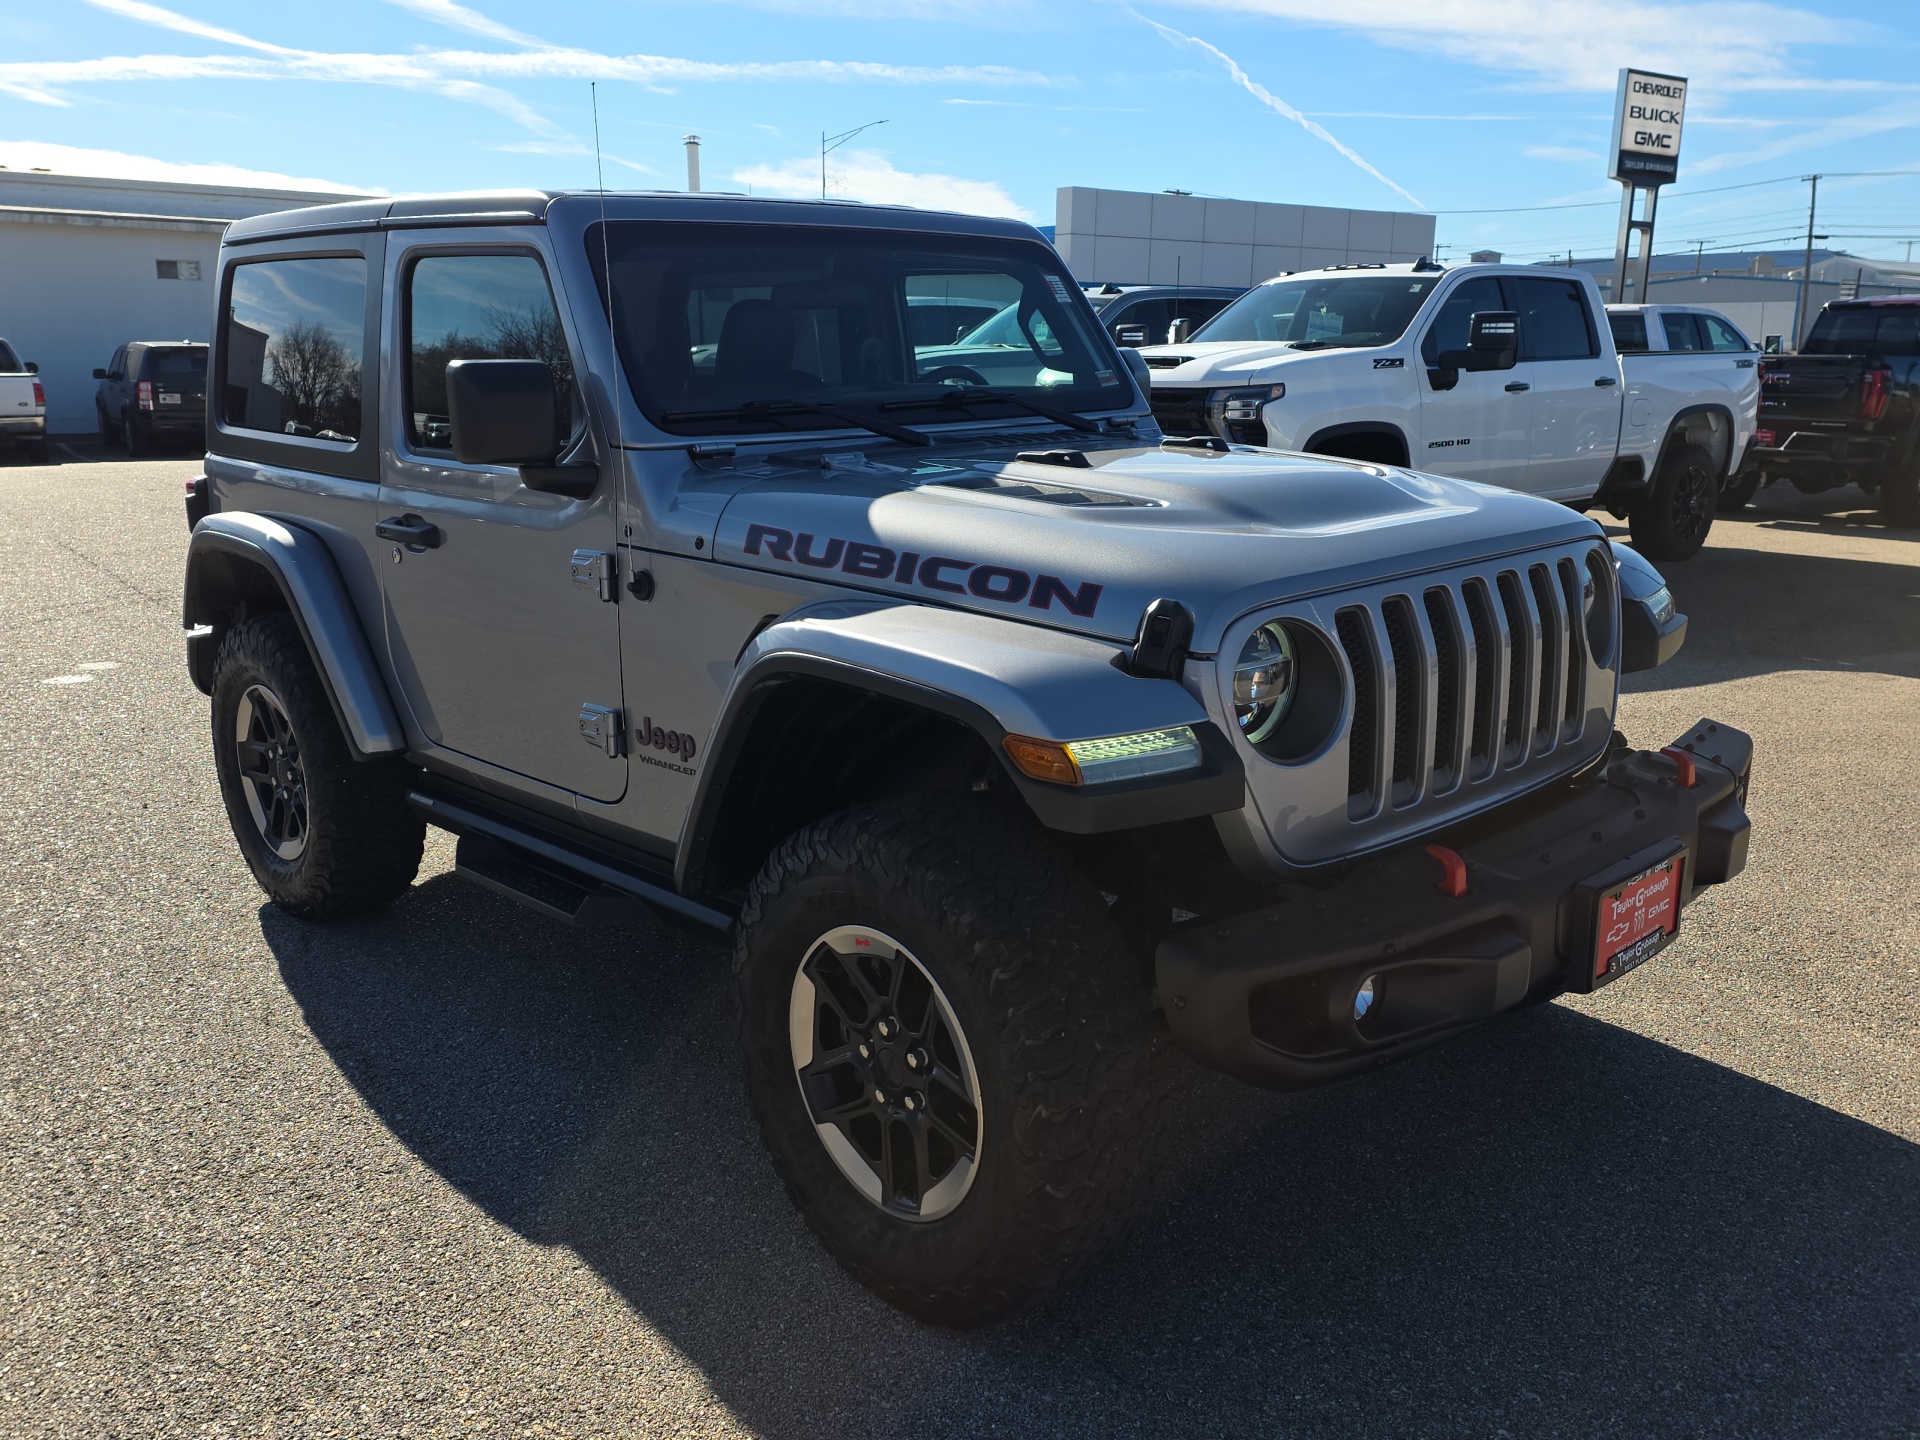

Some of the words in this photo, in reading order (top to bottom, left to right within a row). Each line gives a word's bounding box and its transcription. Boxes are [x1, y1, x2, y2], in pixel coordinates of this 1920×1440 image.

[1633, 81, 1684, 99] CHEVROLET
[1629, 105, 1681, 125] BUICK
[1634, 131, 1672, 148] GMC
[1625, 160, 1645, 169] TAYLOR
[1428, 440, 1455, 449] 2500
[1456, 438, 1470, 446] HD
[743, 523, 1104, 618] RUBICON
[635, 716, 697, 763] Jeep
[639, 753, 697, 776] WRANGLER
[1654, 860, 1668, 873] GMC
[1611, 896, 1636, 920] Taylor
[1635, 876, 1669, 907] Grubaugh
[1648, 898, 1670, 919] GMC
[1617, 949, 1636, 967] Taylor
[1635, 932, 1660, 957] Grubaugh
